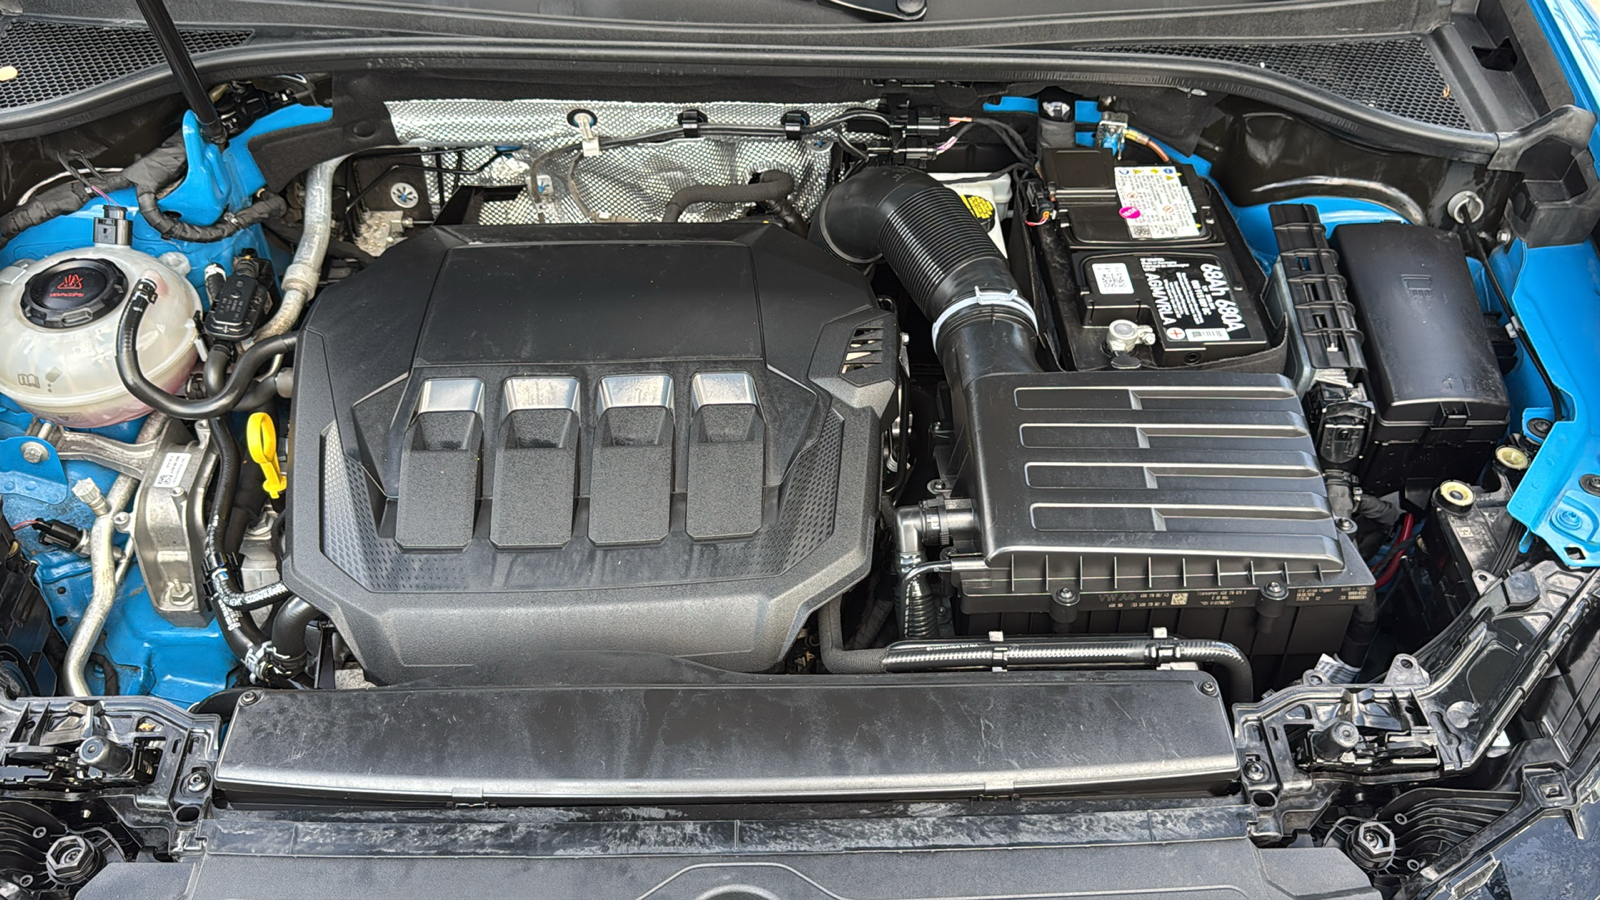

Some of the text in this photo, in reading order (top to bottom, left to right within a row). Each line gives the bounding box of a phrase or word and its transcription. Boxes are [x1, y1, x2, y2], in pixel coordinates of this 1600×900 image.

[1145, 273, 1177, 325] AGM/VRLA
[1200, 263, 1229, 296] 68Ah
[1215, 300, 1245, 332] 680A
